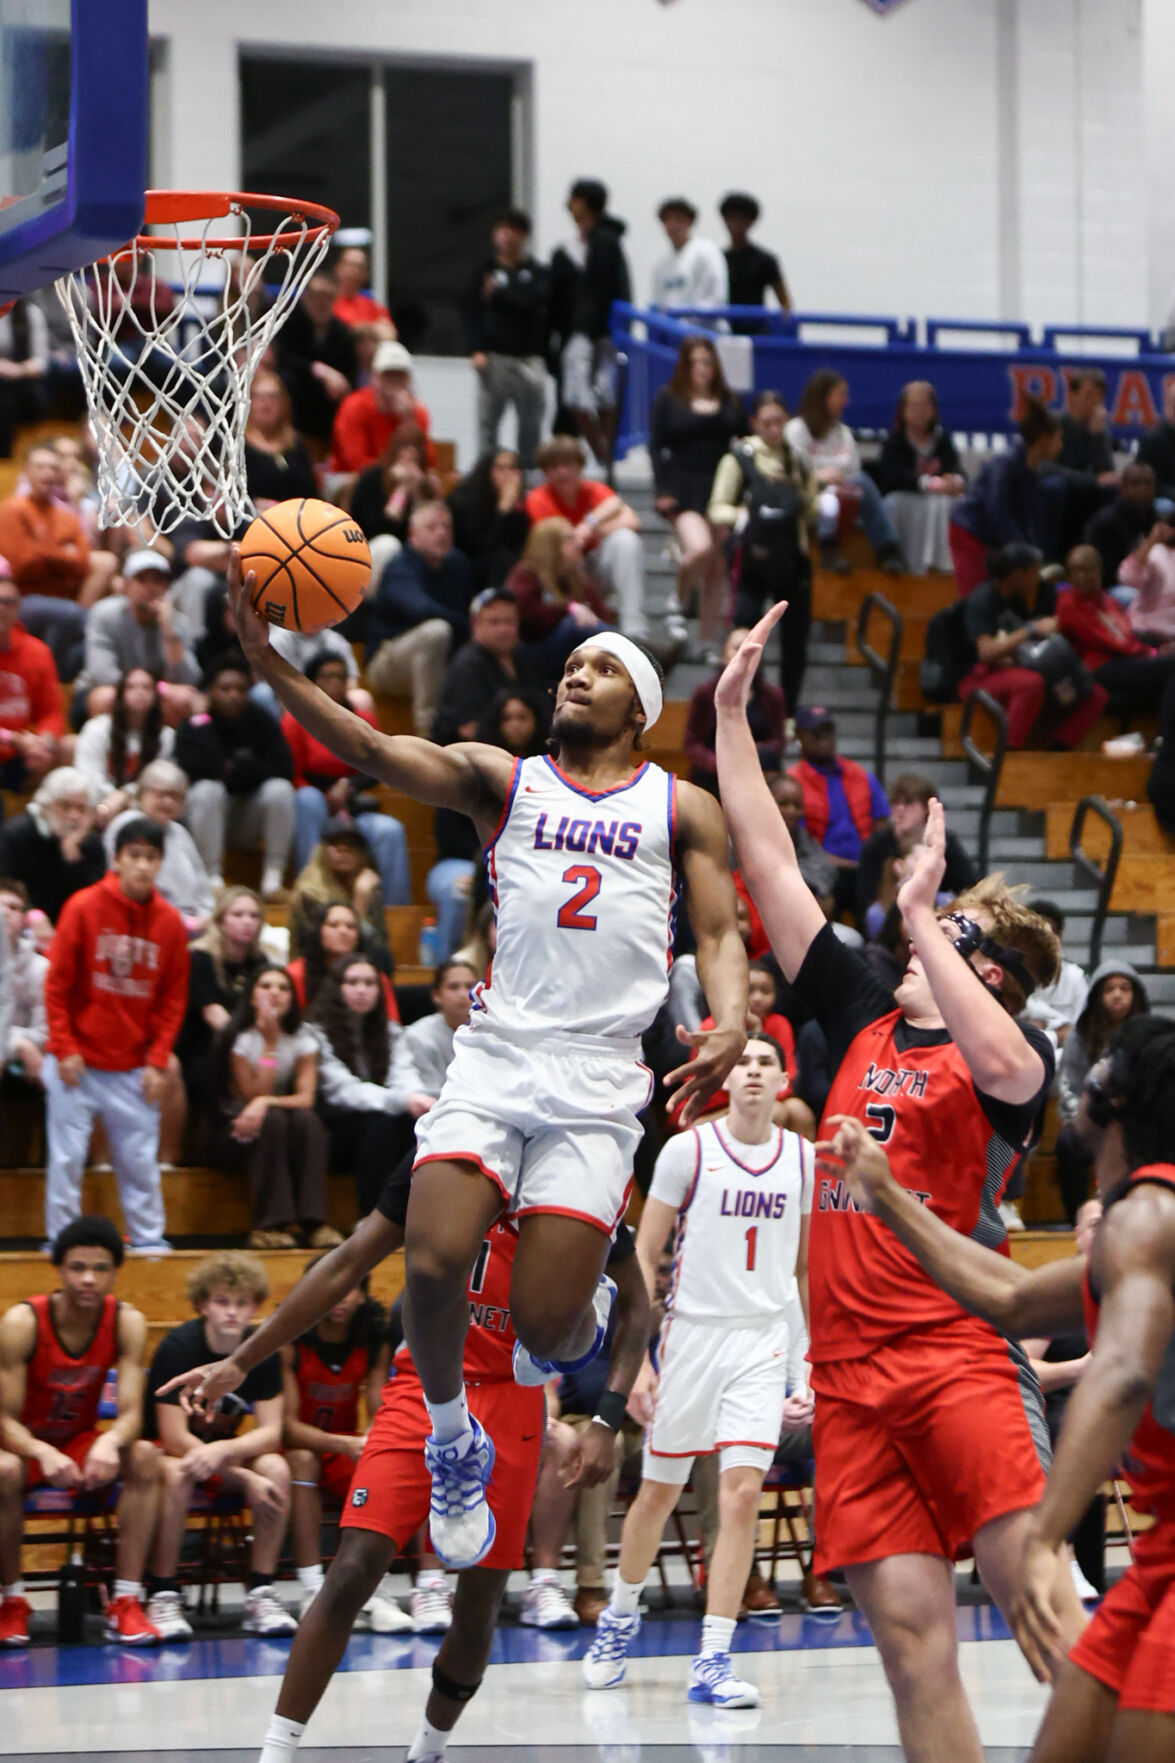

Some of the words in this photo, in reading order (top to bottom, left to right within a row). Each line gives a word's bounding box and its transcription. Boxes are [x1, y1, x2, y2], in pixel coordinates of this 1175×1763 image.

[533, 812, 642, 860] LIONS
[556, 864, 603, 931] 2
[720, 1188, 787, 1219] LIONS
[744, 1225, 759, 1271] 1
